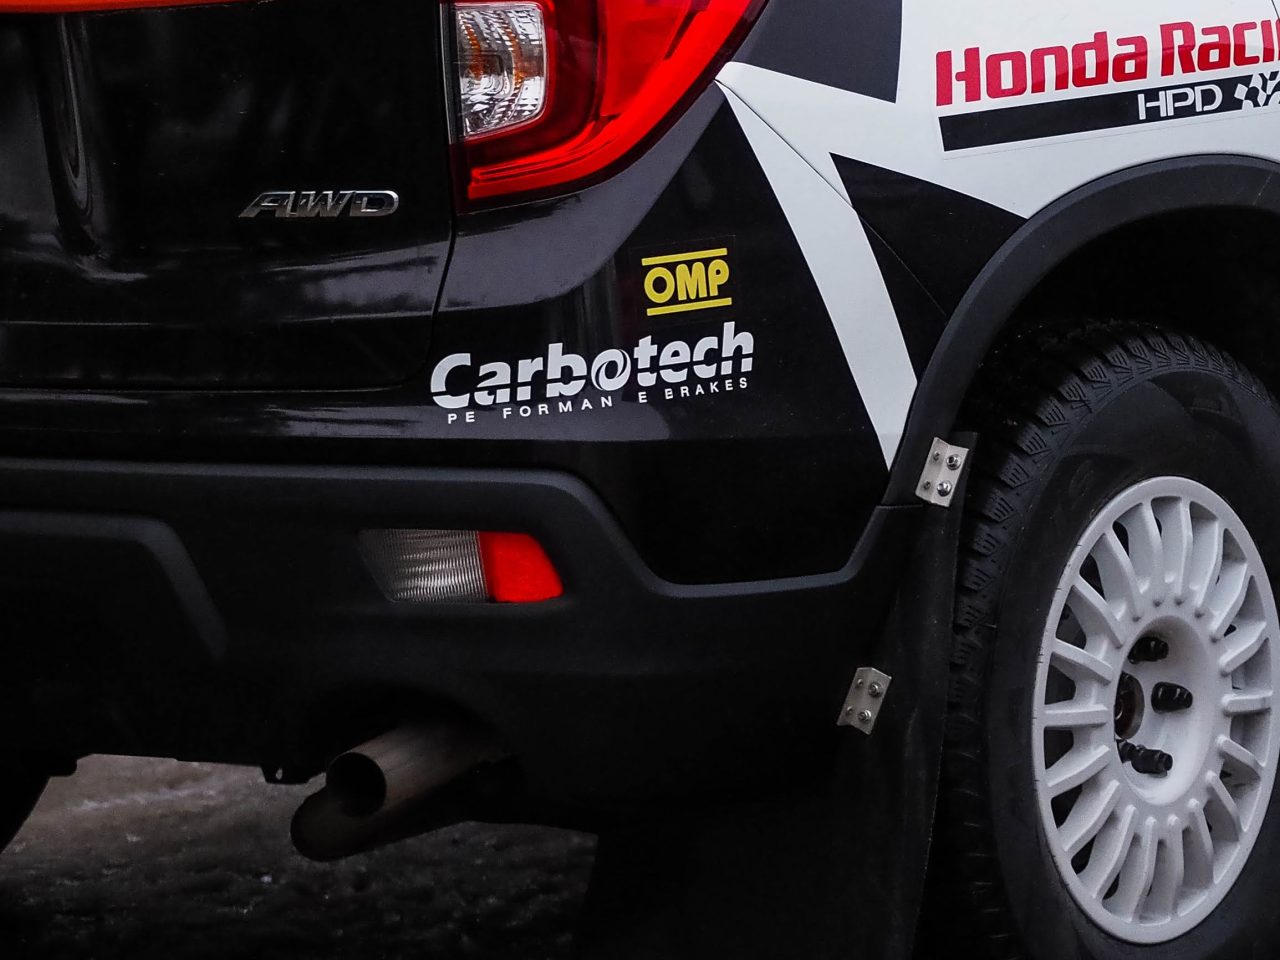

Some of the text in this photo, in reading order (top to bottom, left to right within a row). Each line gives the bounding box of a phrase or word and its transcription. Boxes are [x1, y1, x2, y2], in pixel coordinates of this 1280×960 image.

[935, 31, 1148, 107] Honda
[1138, 84, 1223, 121] HPD
[238, 190, 400, 218] AWD
[644, 259, 730, 303] OMP
[430, 321, 754, 409] Carbotech
[665, 377, 748, 400] BRAKES
